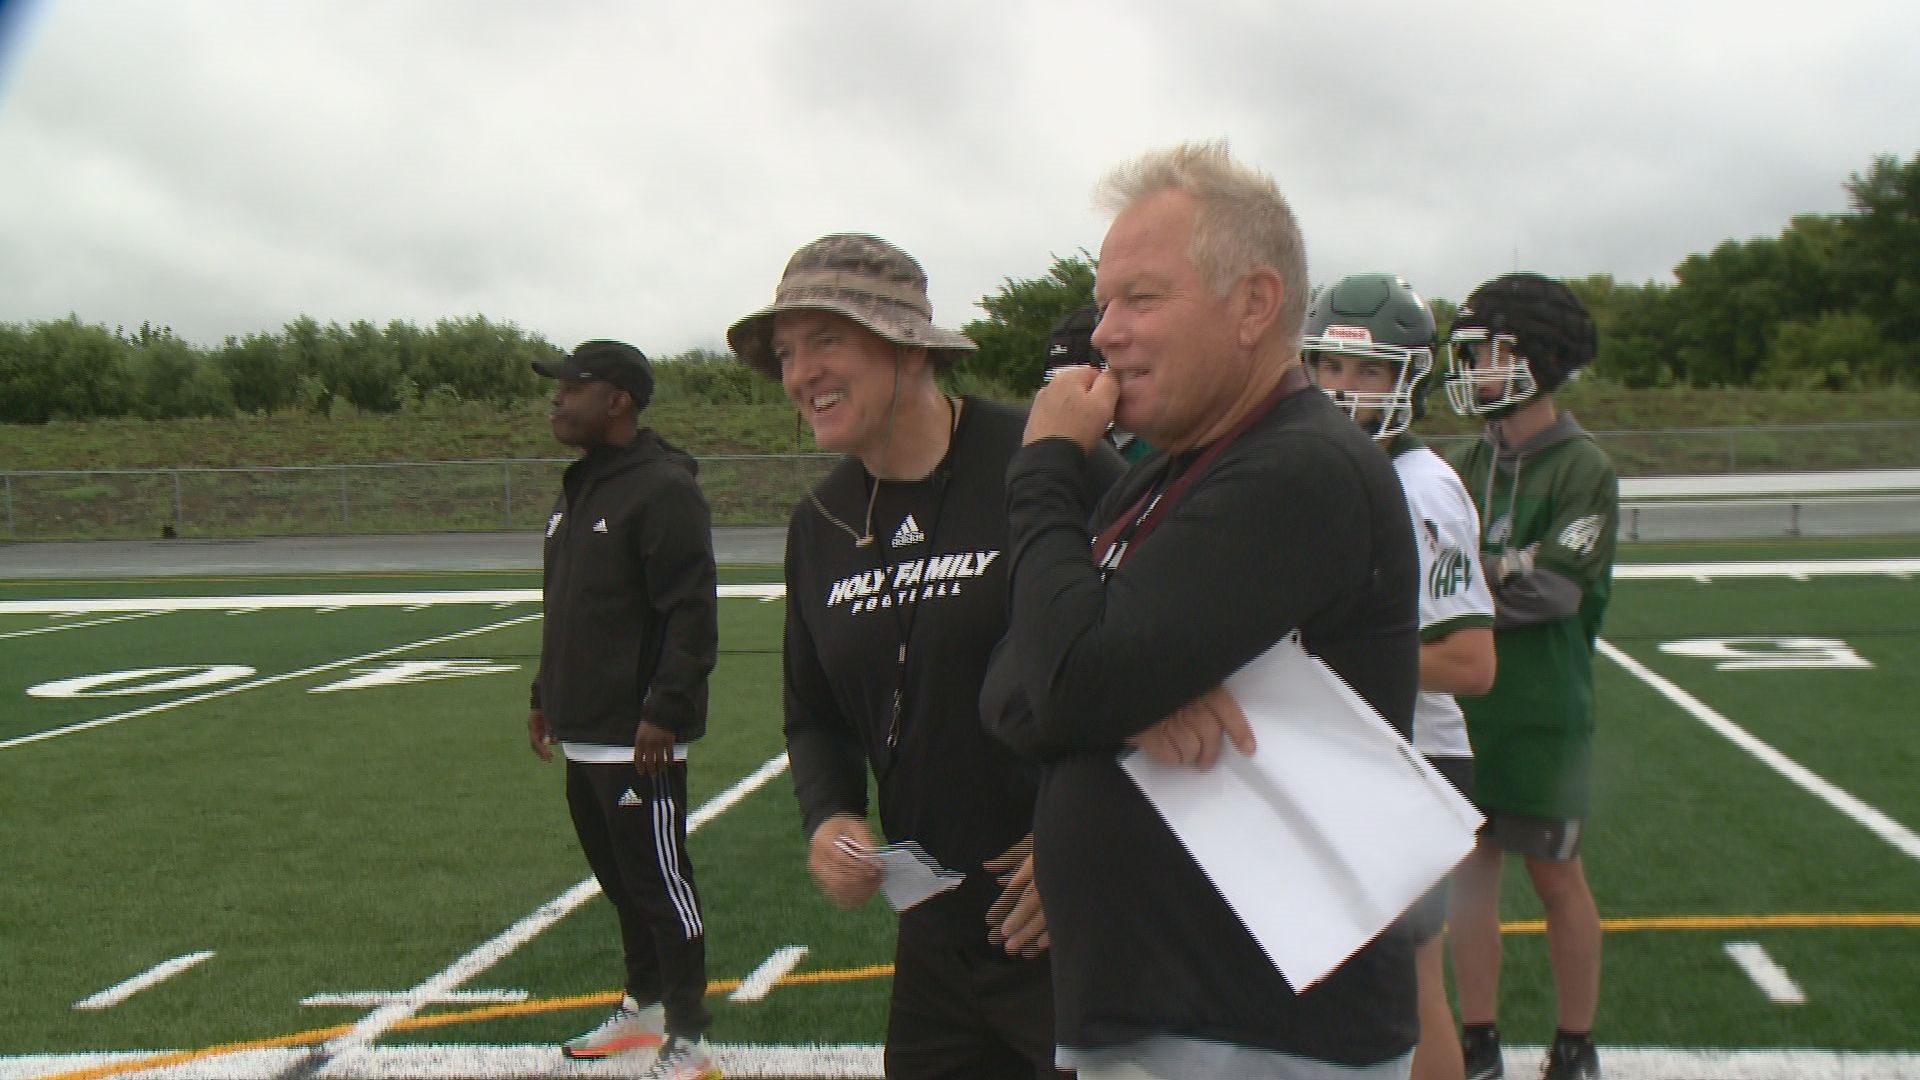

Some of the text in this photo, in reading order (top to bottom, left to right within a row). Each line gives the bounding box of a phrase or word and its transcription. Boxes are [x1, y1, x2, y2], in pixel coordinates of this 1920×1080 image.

[891, 531, 925, 548] adidas
[827, 550, 1001, 608] HOLY FAMILY
